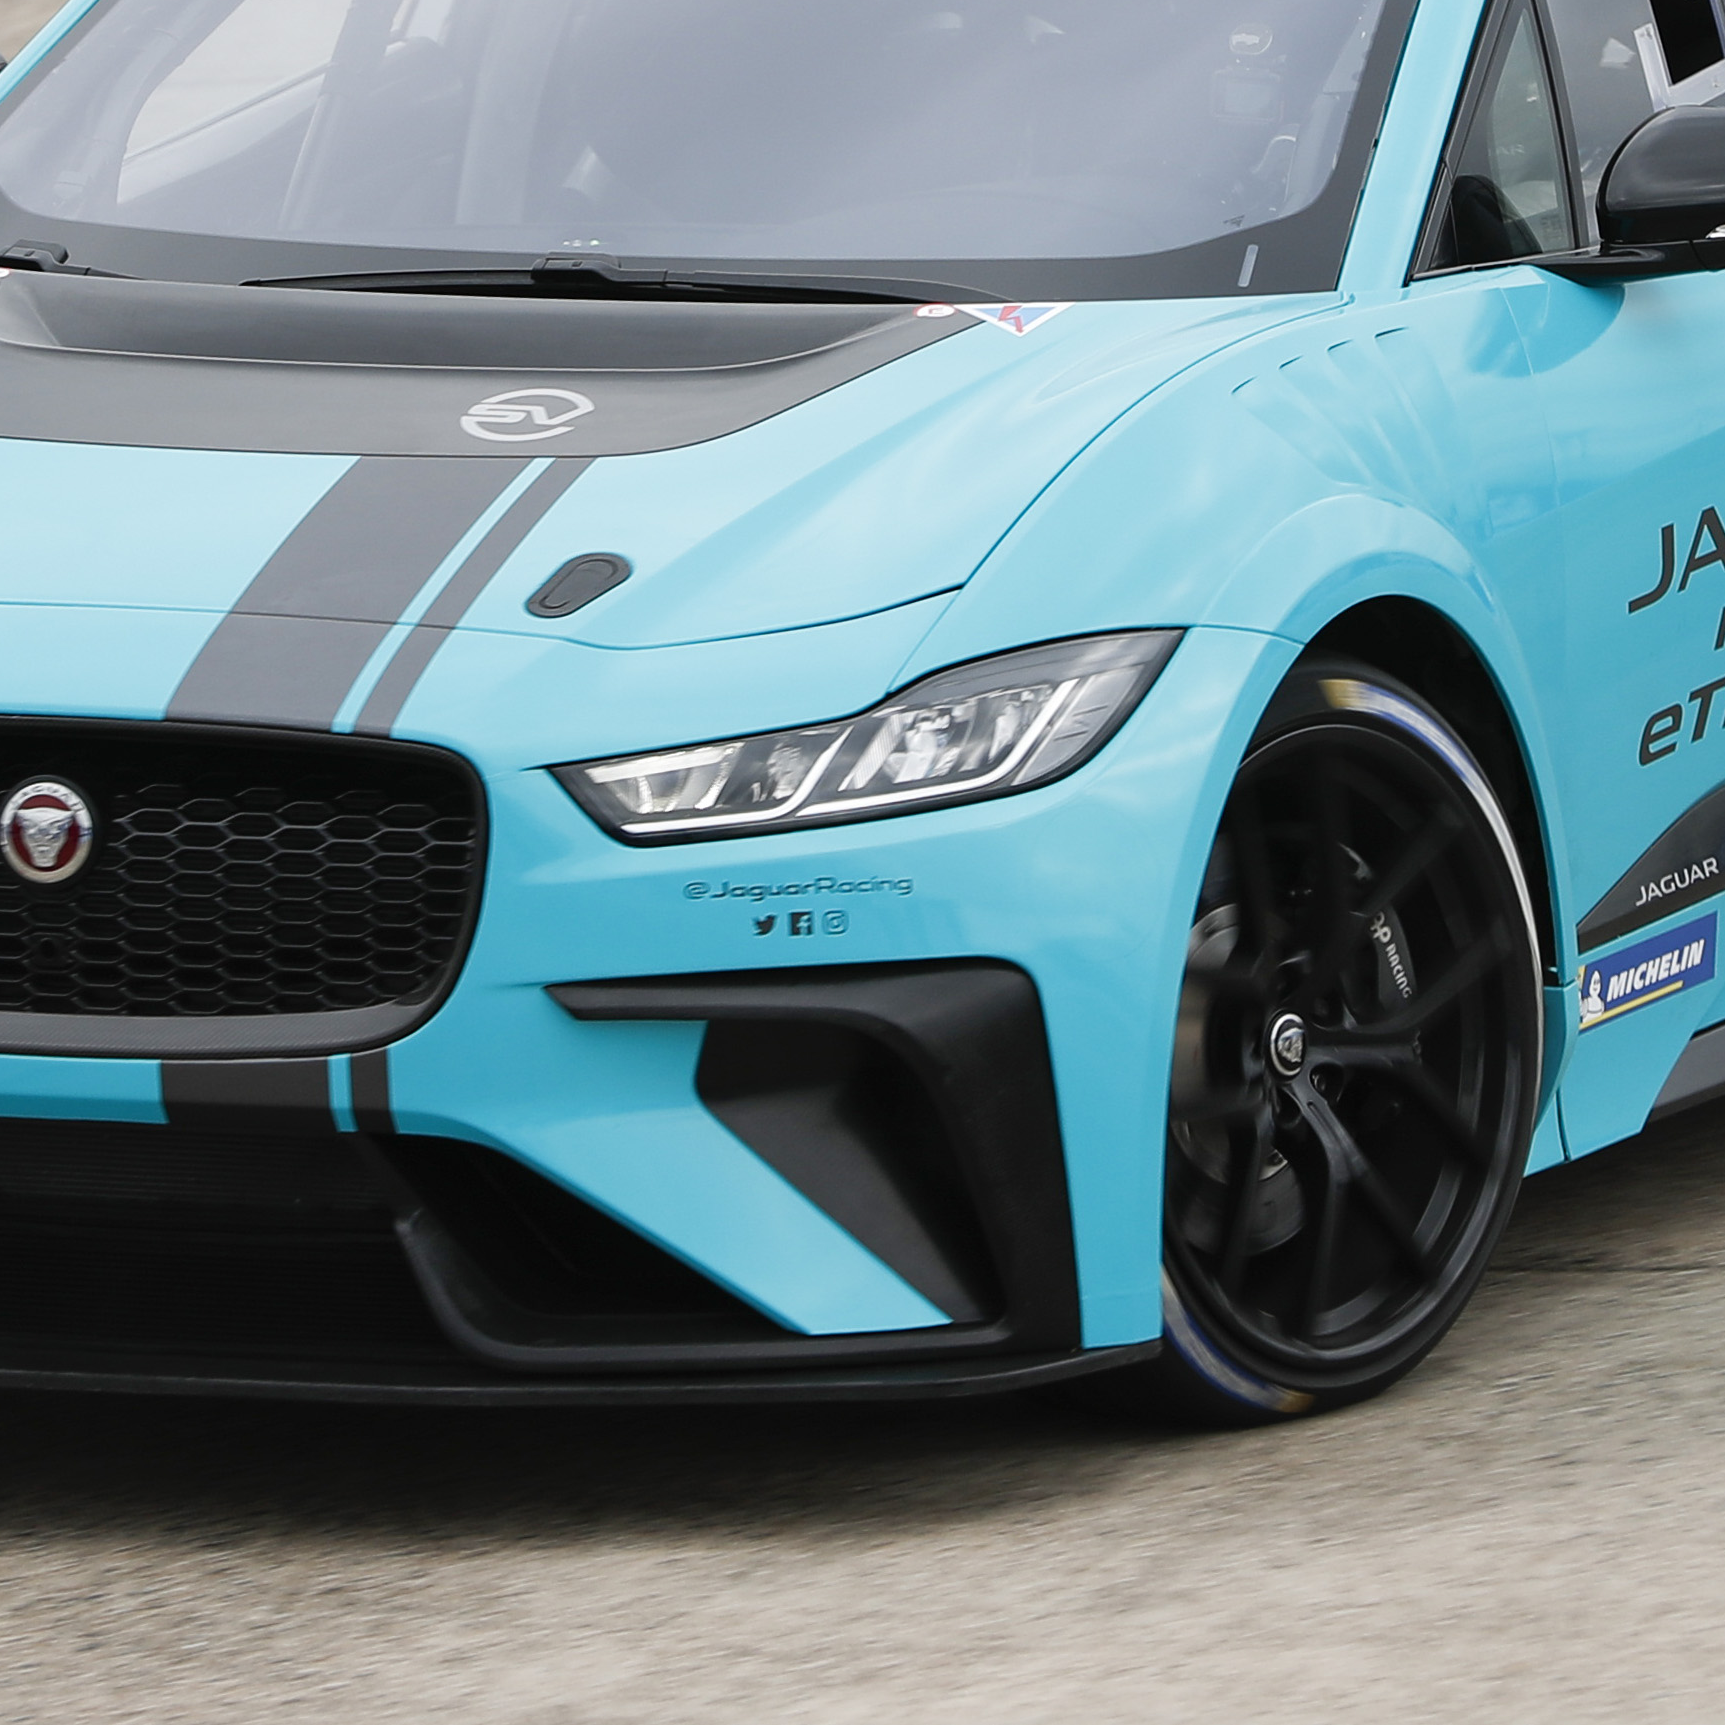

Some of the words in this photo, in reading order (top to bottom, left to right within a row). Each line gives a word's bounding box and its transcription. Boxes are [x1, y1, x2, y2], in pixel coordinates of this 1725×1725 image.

[683, 876, 914, 902] @JaguarRacing
[1635, 856, 1720, 907] JAGUAR
[1385, 942, 1413, 999] RACING
[1606, 938, 1706, 1002] MICHELIN
